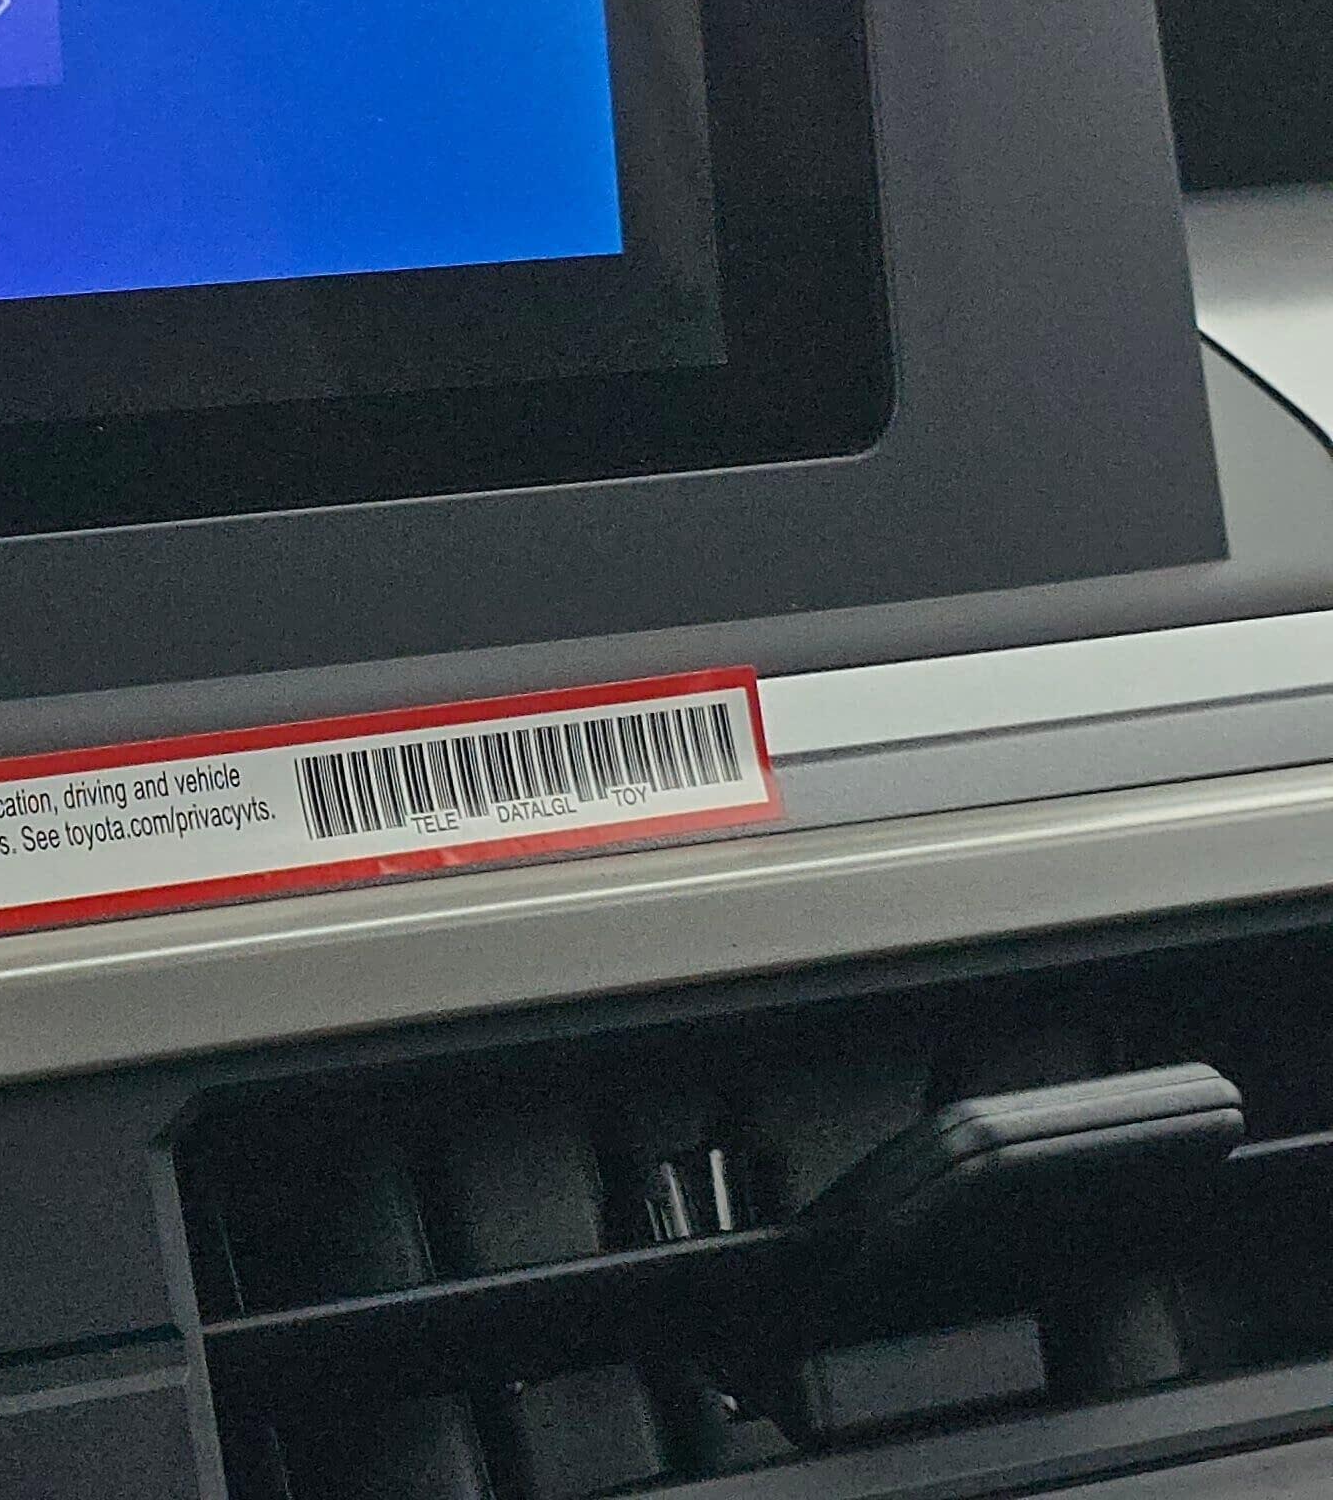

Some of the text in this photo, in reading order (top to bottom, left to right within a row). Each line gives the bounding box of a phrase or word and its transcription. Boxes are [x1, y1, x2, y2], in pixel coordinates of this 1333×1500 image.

[63, 779, 128, 810] driving
[133, 771, 170, 800] and
[174, 762, 241, 794] vehicle
[410, 812, 459, 835] TELE
[611, 786, 648, 808] TOY
[22, 825, 61, 853] See
[65, 799, 276, 851] toyota.com/privacyvts.
